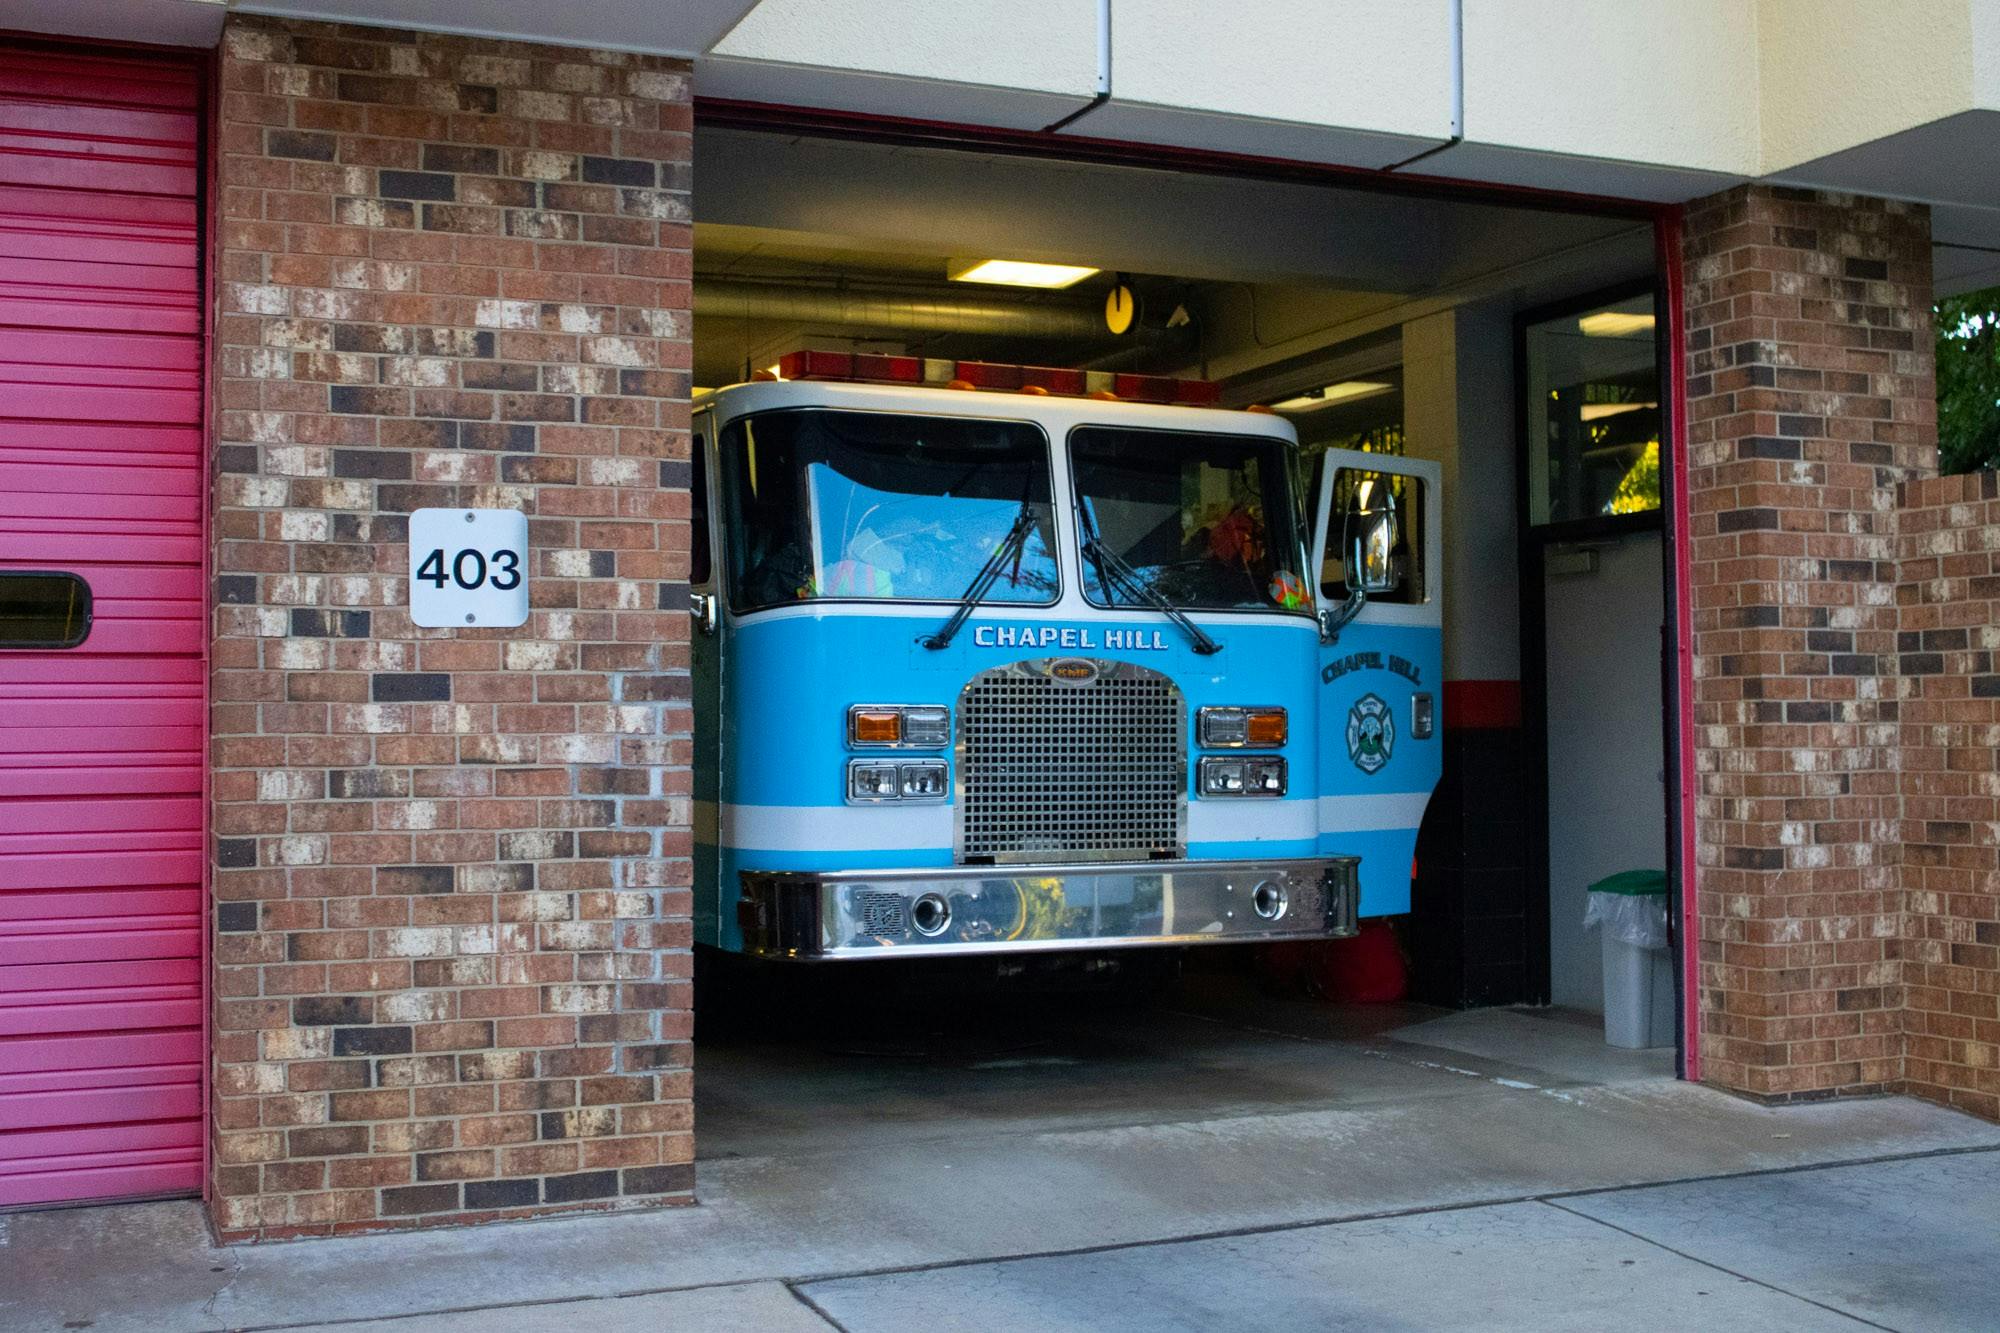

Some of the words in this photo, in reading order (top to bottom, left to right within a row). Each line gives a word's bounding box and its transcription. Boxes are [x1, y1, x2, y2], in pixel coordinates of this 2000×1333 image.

[416, 548, 521, 590] 403
[974, 626, 1096, 648] CHAPEL
[1104, 630, 1169, 650] HILL
[1321, 652, 1385, 685] CHAPEL
[1388, 654, 1422, 686] HILL
